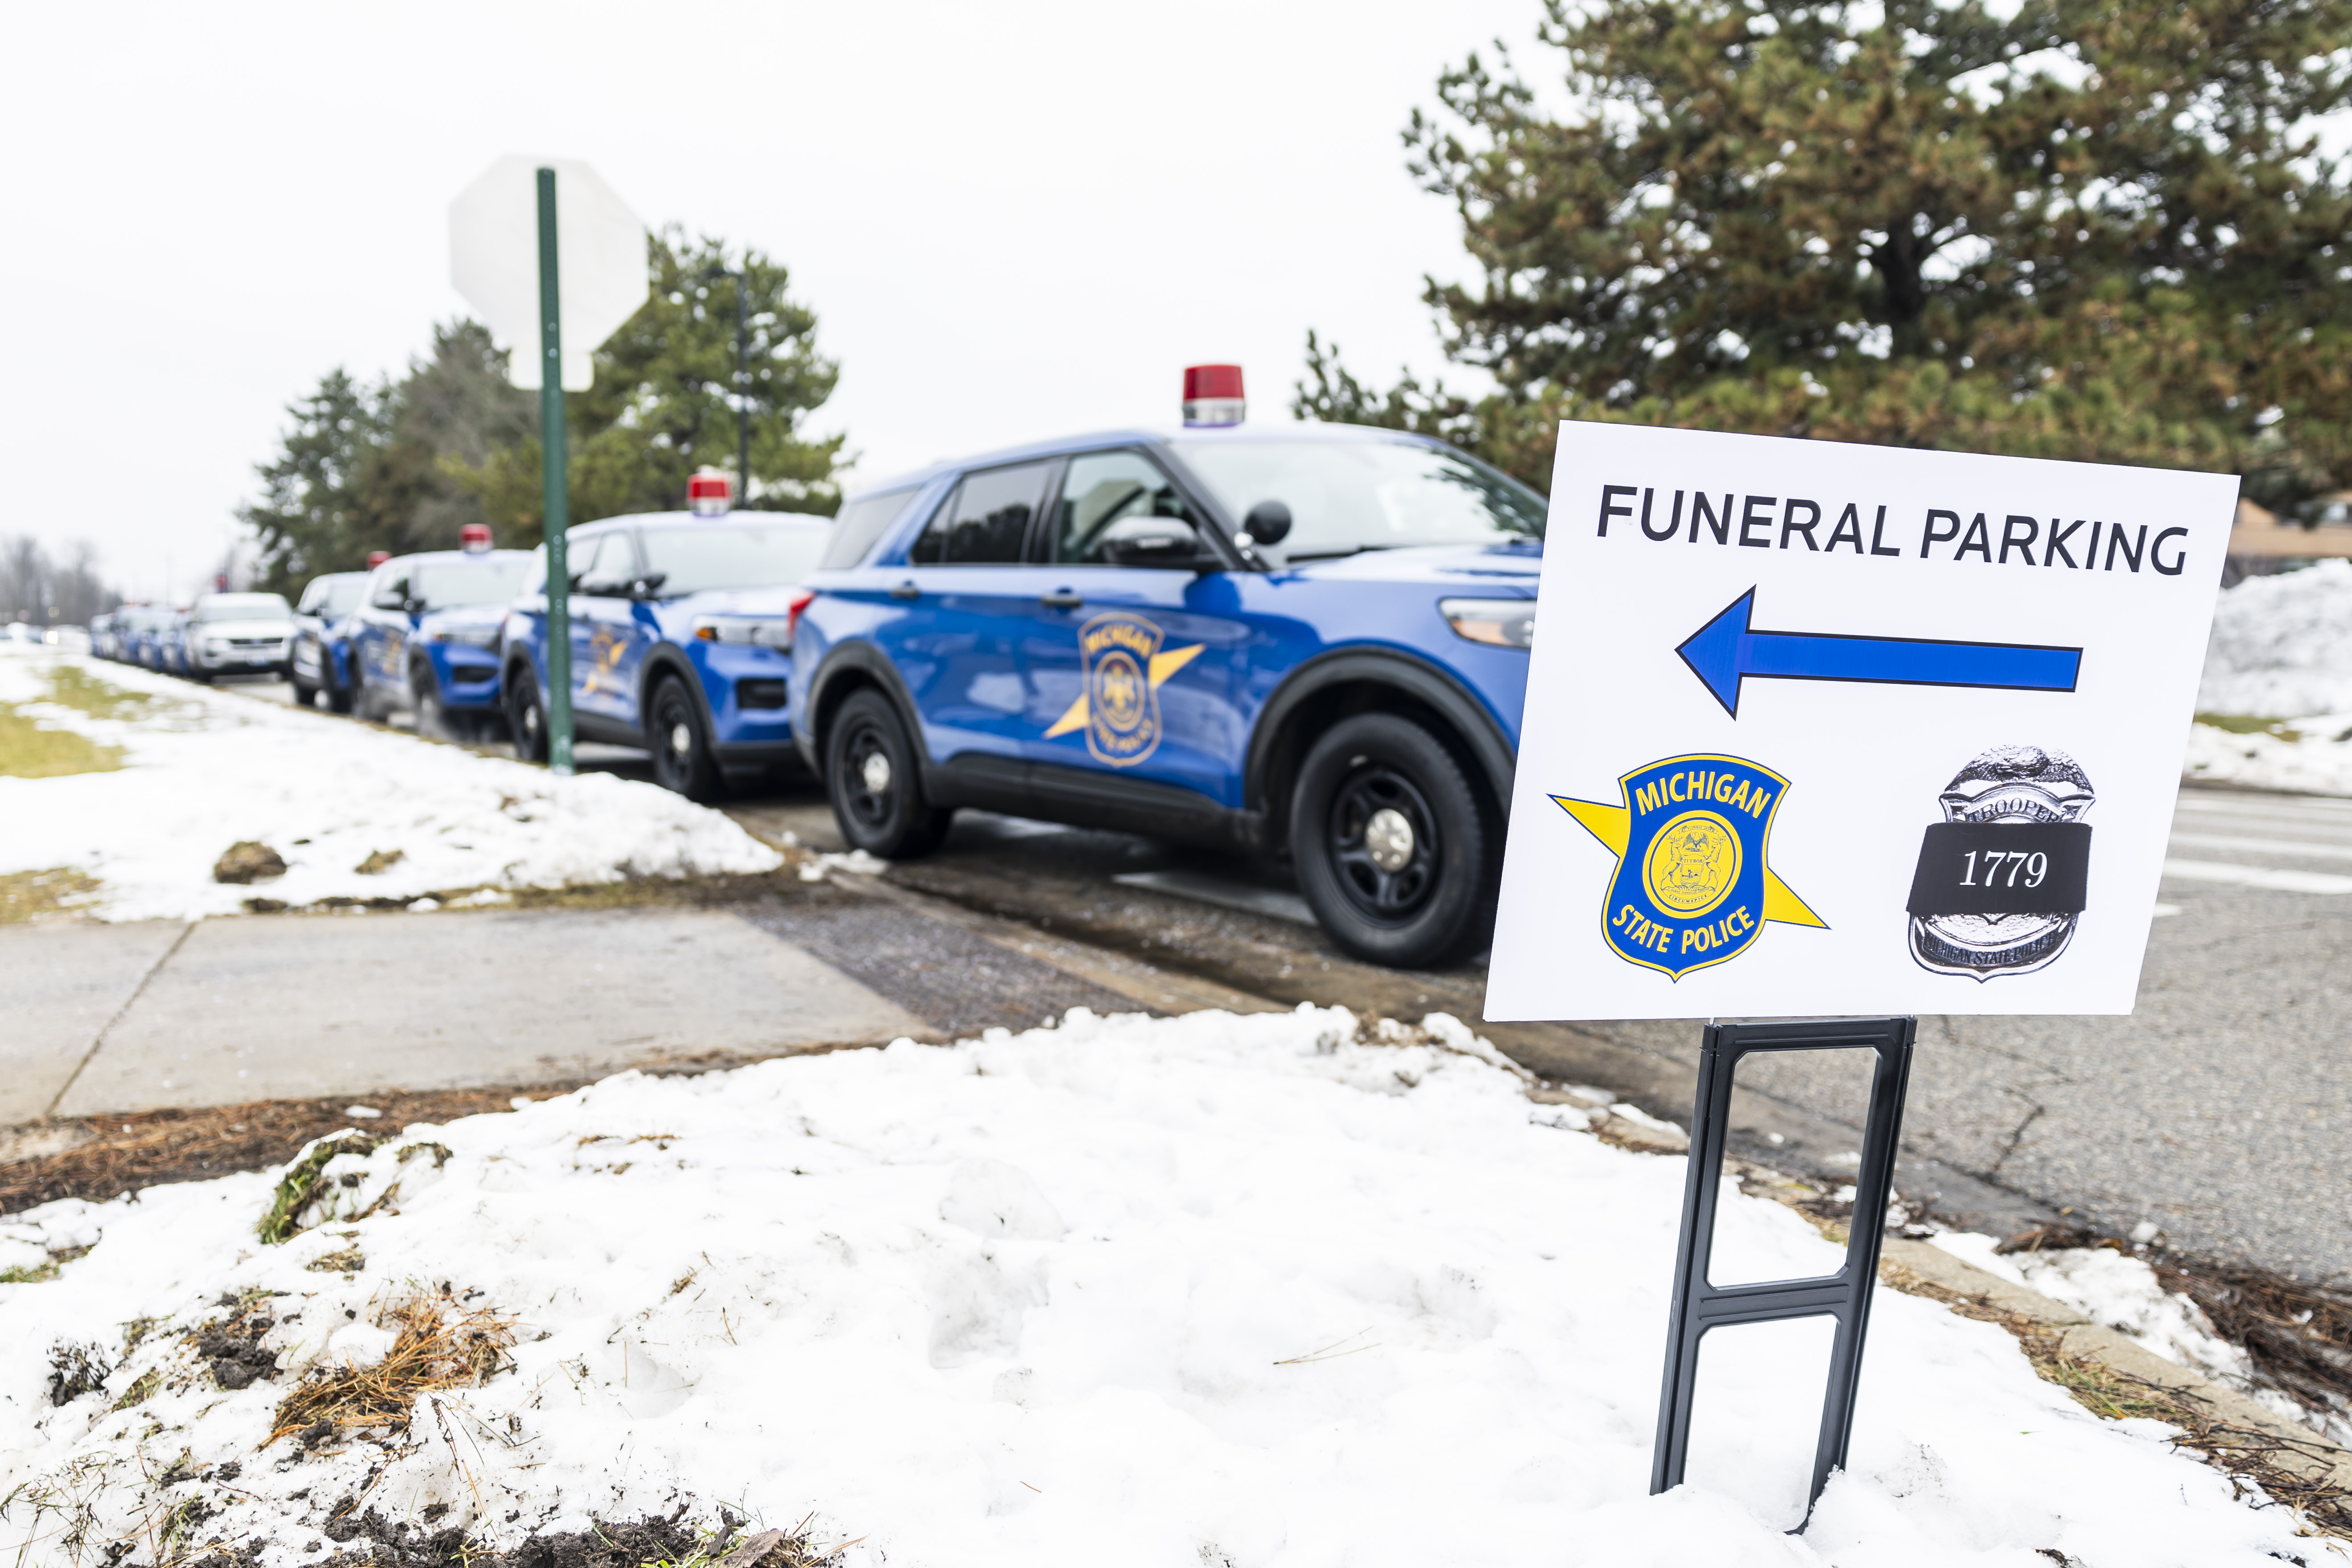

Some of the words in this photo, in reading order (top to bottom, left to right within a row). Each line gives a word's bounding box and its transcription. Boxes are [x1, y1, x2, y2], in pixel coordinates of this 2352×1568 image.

[1597, 484, 1901, 557] FUNERAL
[1920, 509, 2189, 576] PARKING
[1635, 771, 1771, 818] MICHIGAN
[1960, 850, 2047, 887] 1779
[1613, 904, 1673, 953] STATE
[1682, 906, 1754, 954] POLICE
[1925, 932, 1972, 964] MICHIGAN
[1974, 949, 2011, 965] STATE
[2014, 933, 2055, 958] POLICE
